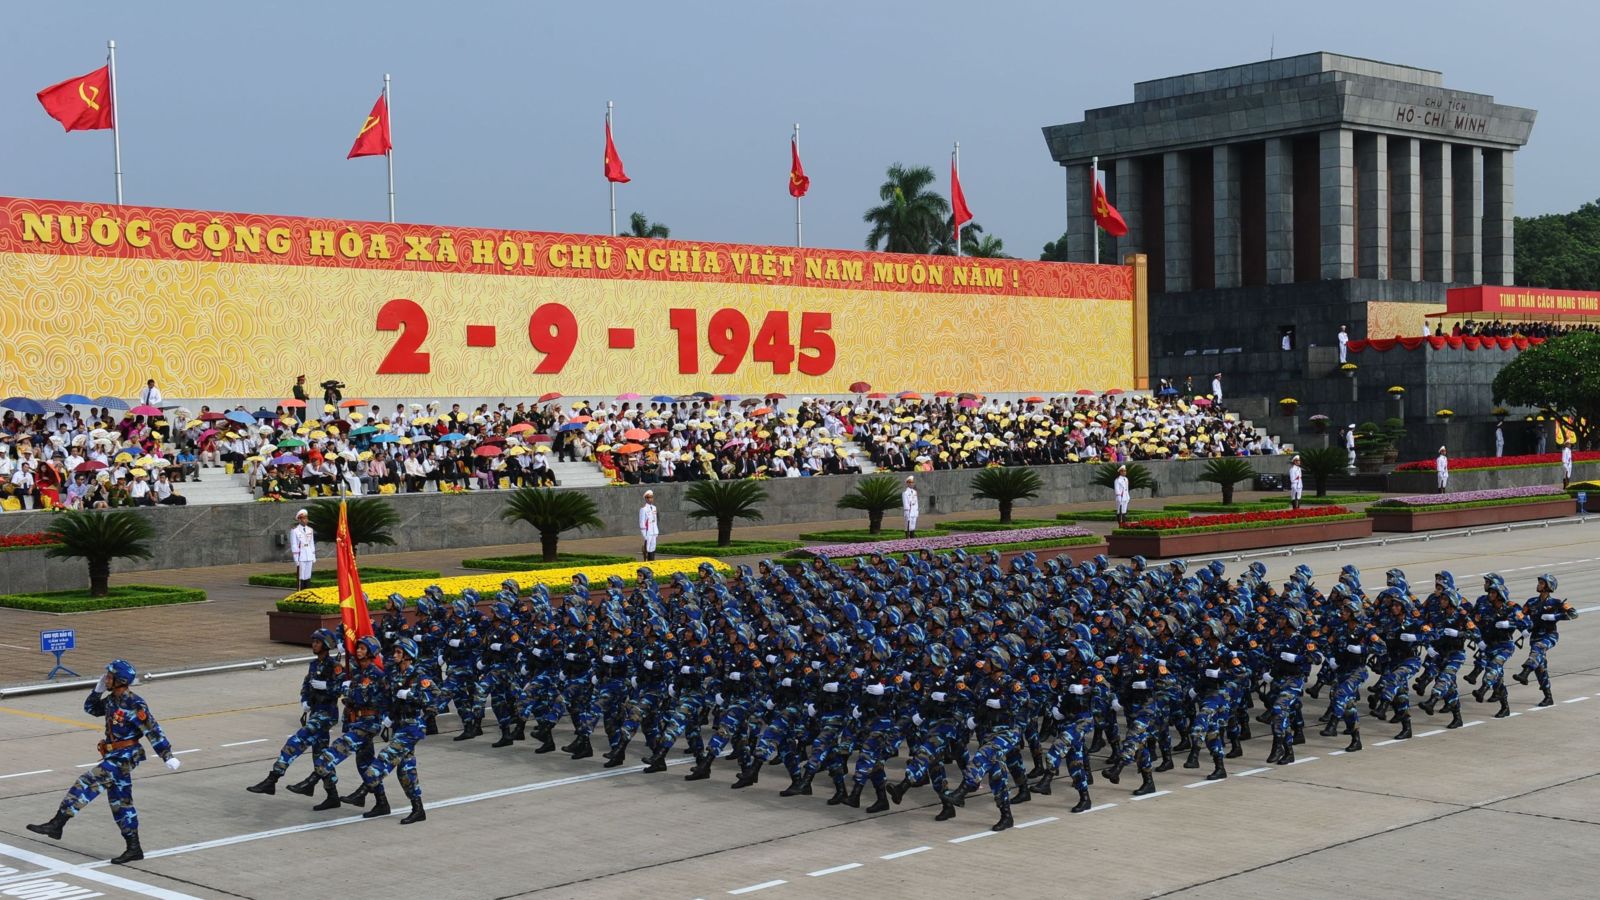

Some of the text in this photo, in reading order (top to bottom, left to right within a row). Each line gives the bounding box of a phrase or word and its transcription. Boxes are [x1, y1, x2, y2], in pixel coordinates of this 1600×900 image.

[23, 210, 152, 249] NƯỚC
[172, 217, 292, 257] CỘNG
[309, 226, 391, 259] HÒA
[404, 232, 459, 263] XÃ
[473, 236, 535, 271] HỘI
[549, 240, 612, 270] CHỦ
[625, 246, 721, 274] NGHĨA
[732, 250, 794, 282] VIỆT
[805, 257, 864, 282] NAM
[873, 259, 944, 286] MUÔN
[952, 262, 1004, 288] NĂM
[670, 307, 836, 376] 1945
